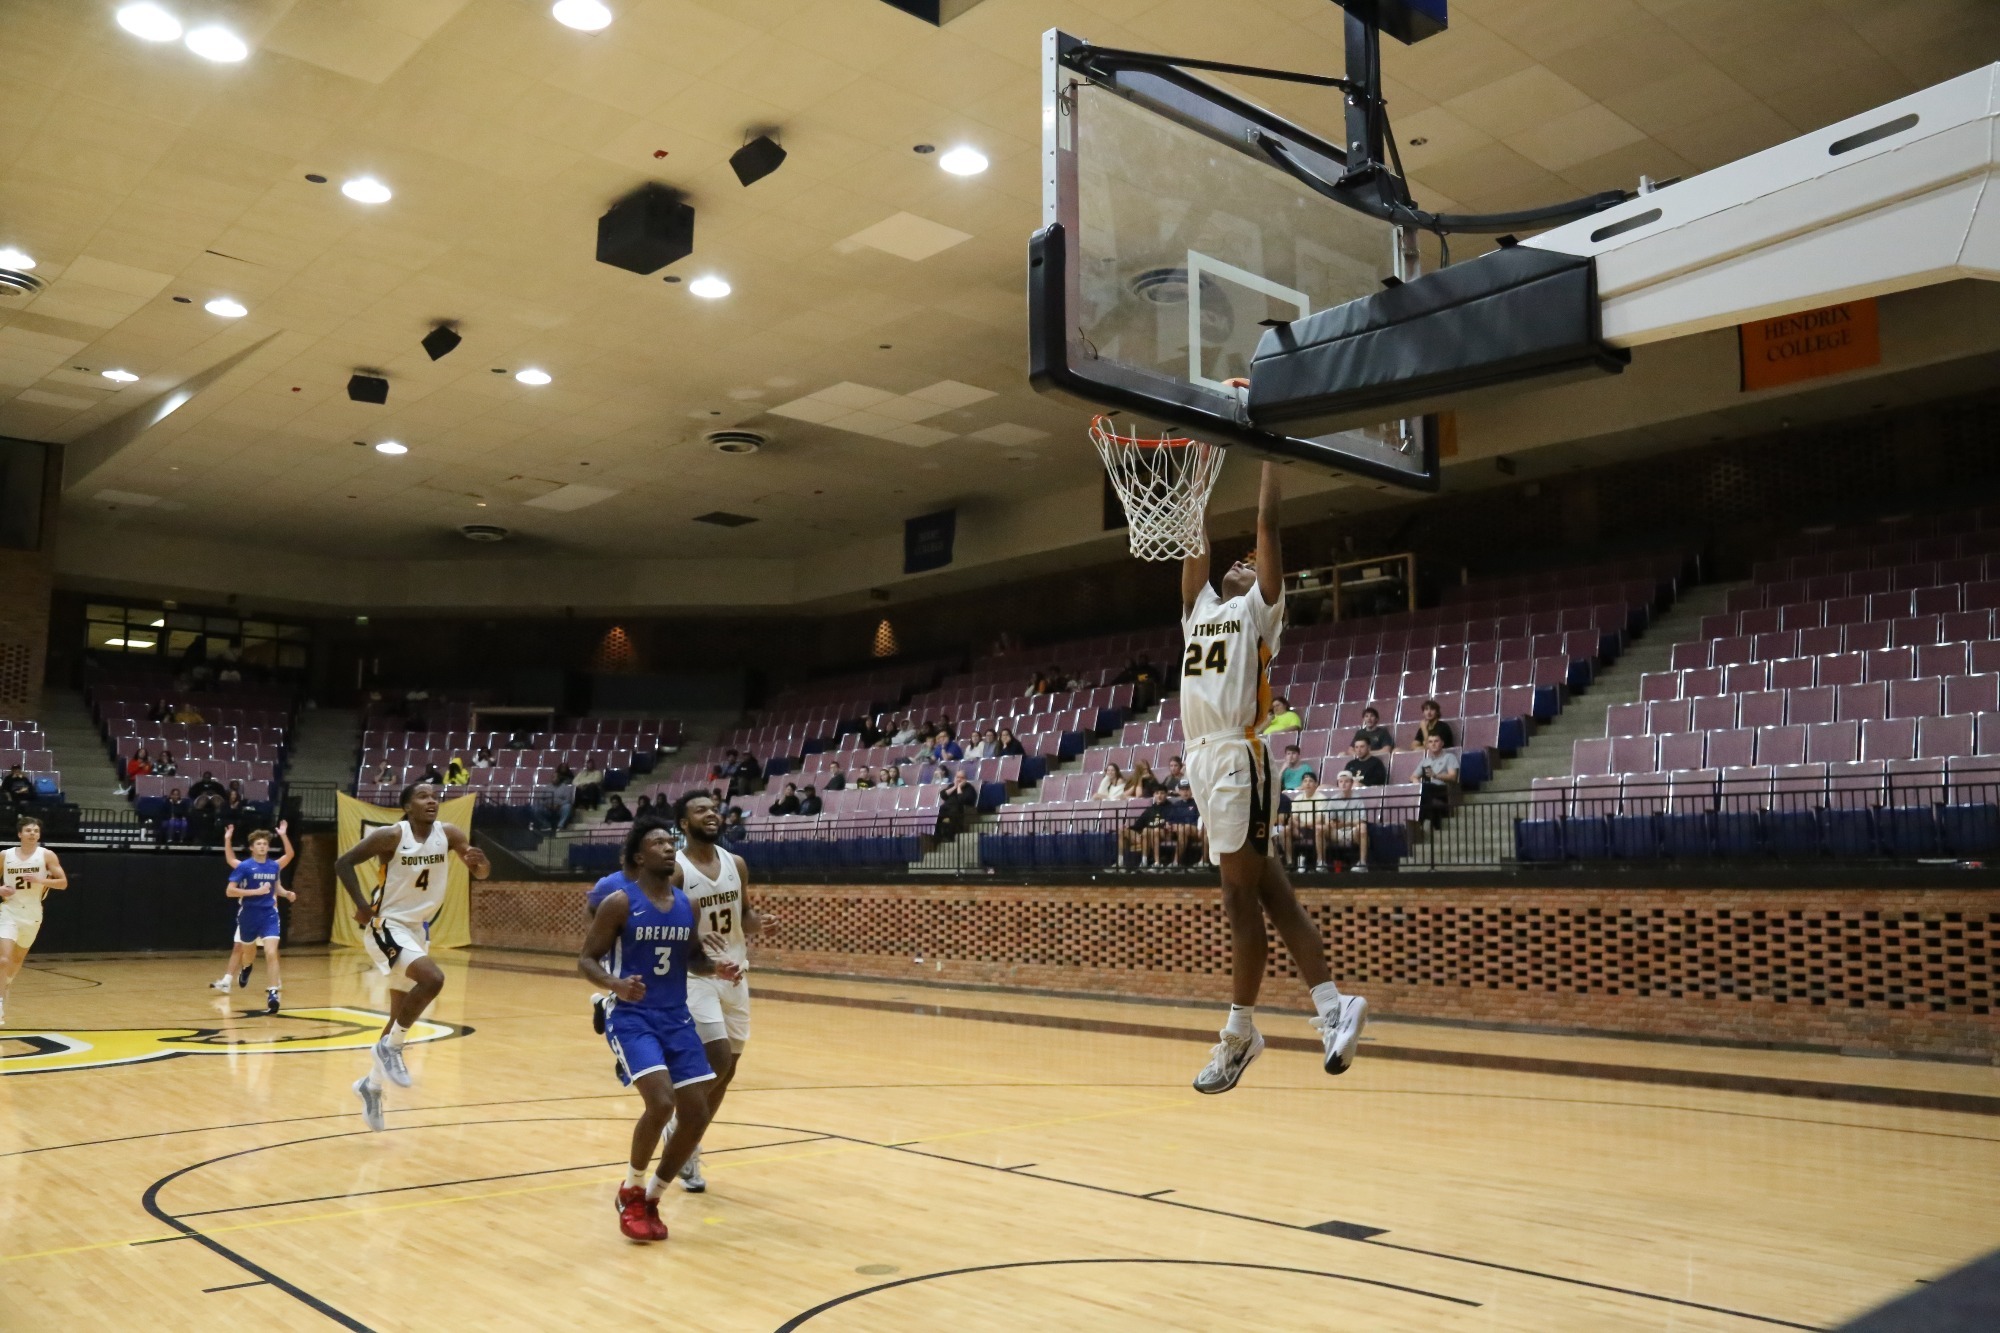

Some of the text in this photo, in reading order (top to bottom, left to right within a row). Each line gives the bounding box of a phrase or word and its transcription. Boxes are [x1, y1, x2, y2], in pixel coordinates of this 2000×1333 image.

[1765, 306, 1851, 341] HENDRIX
[1766, 329, 1851, 362] COLLEGE
[1184, 640, 1227, 676] 24
[7, 867, 40, 875] SOUTHERN
[401, 853, 445, 866] SOUTHERN
[415, 869, 430, 891] 4
[699, 890, 739, 909] OUTHERN
[635, 925, 690, 941] BREVARD
[709, 908, 732, 935] 13
[653, 946, 671, 976] 3
